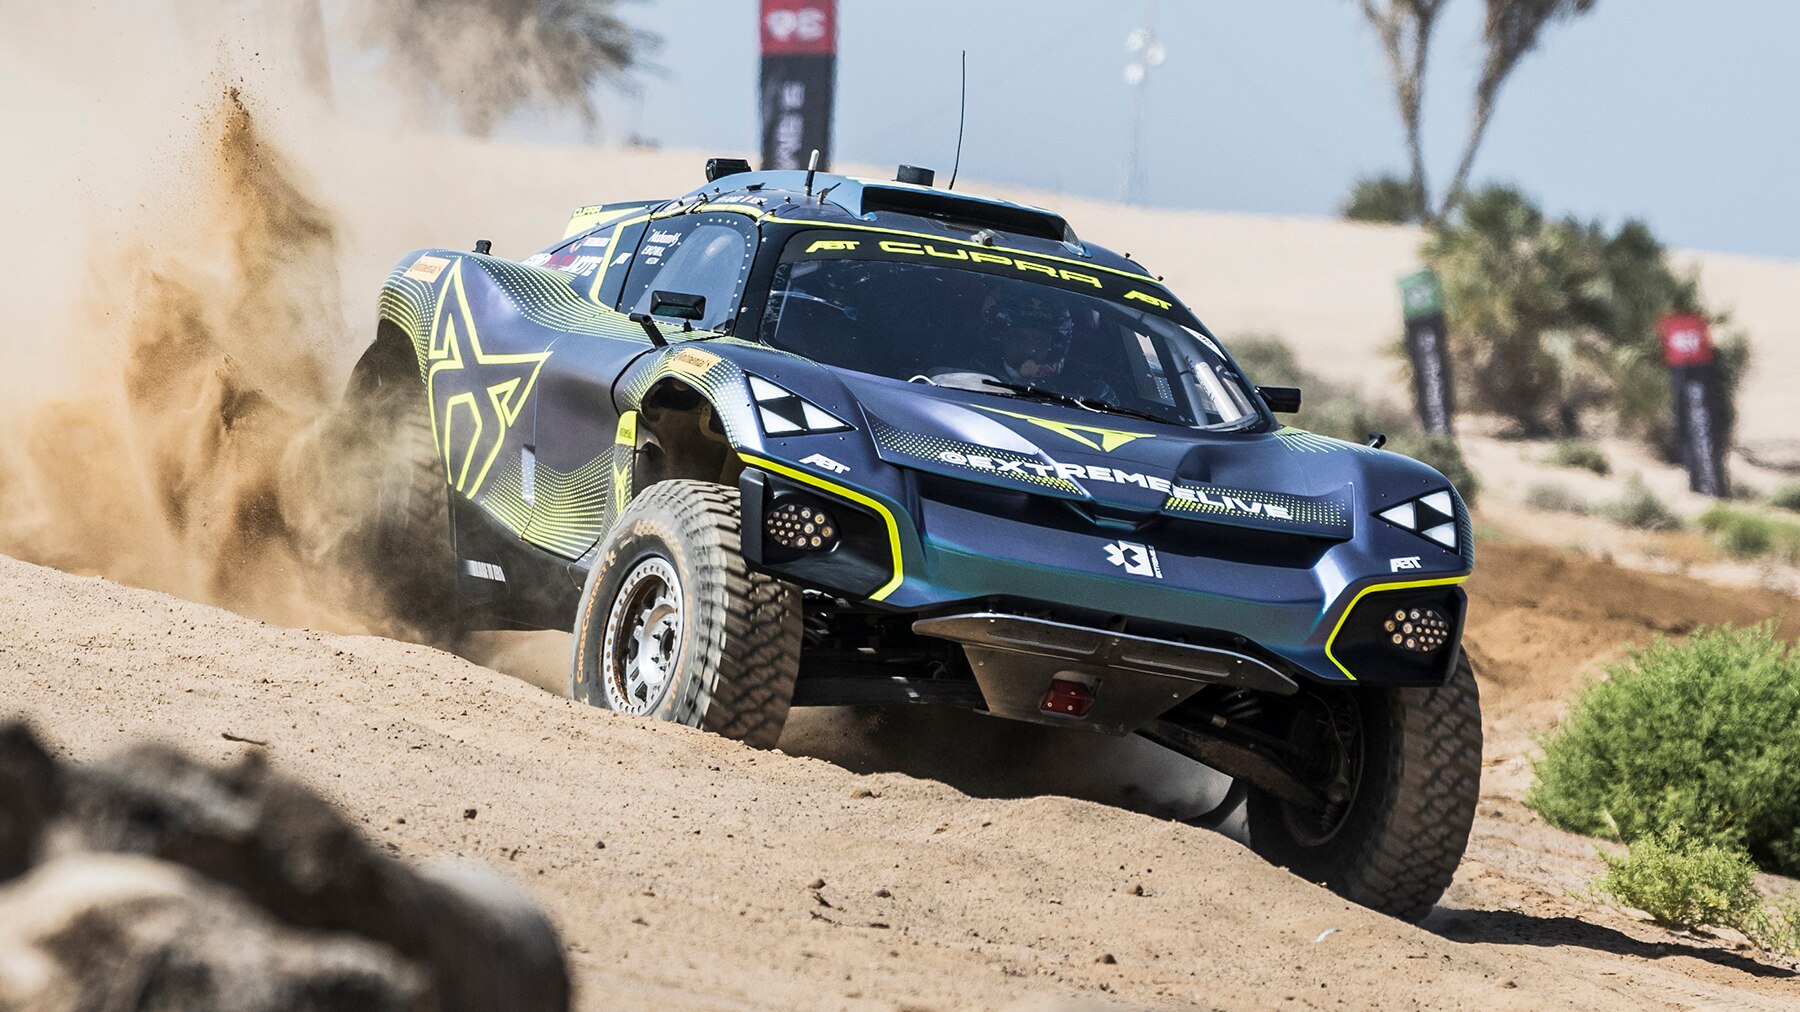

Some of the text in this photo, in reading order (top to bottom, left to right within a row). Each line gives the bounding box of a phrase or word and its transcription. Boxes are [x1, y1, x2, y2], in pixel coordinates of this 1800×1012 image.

[805, 240, 1172, 310] ABT CUPRA ABT
[799, 453, 851, 474] ABT
[1390, 556, 1422, 572] ABT
